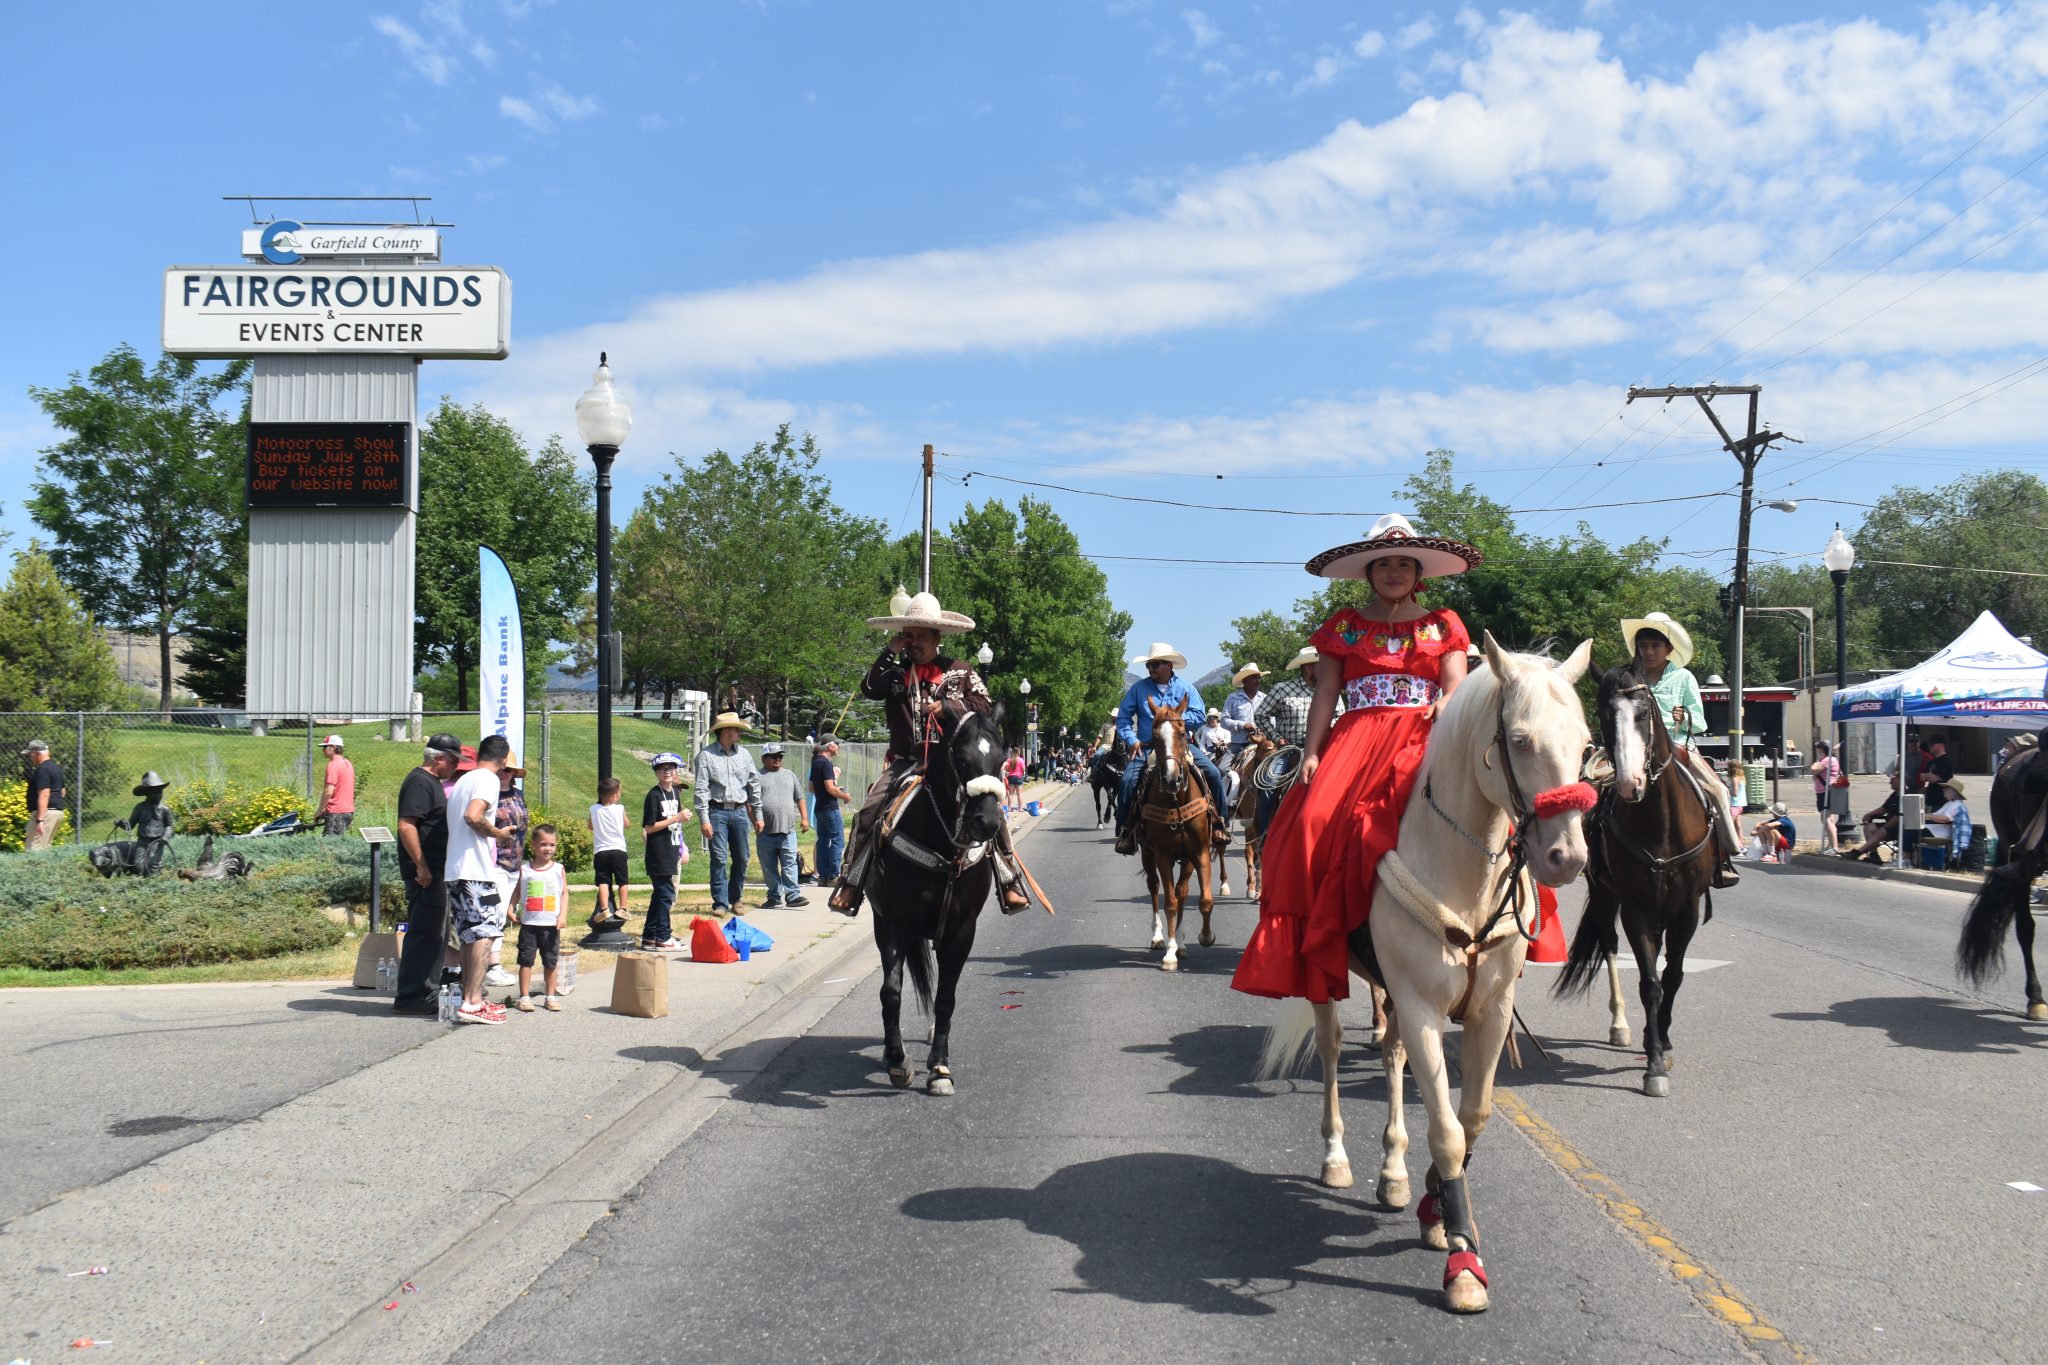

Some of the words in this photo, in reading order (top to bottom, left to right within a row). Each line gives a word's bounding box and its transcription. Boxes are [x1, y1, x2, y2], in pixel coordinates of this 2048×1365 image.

[310, 236, 367, 251] Garfield
[372, 236, 423, 251] County
[183, 275, 481, 308] FAIRGROUNDS
[326, 309, 335, 320] &
[239, 323, 324, 342] EVENTS
[334, 323, 423, 342] CENTER
[257, 436, 345, 450] Motocross
[353, 436, 395, 450] Show
[253, 450, 312, 463] Sunday
[320, 450, 354, 463] July
[362, 450, 400, 463] 28th
[258, 464, 288, 477] Buy
[297, 463, 355, 477] tickets
[364, 465, 385, 477] on
[252, 479, 281, 490] our
[290, 477, 354, 490] website
[362, 477, 398, 490] now!
[498, 615, 508, 666] Bank
[495, 673, 509, 740] Alpine
